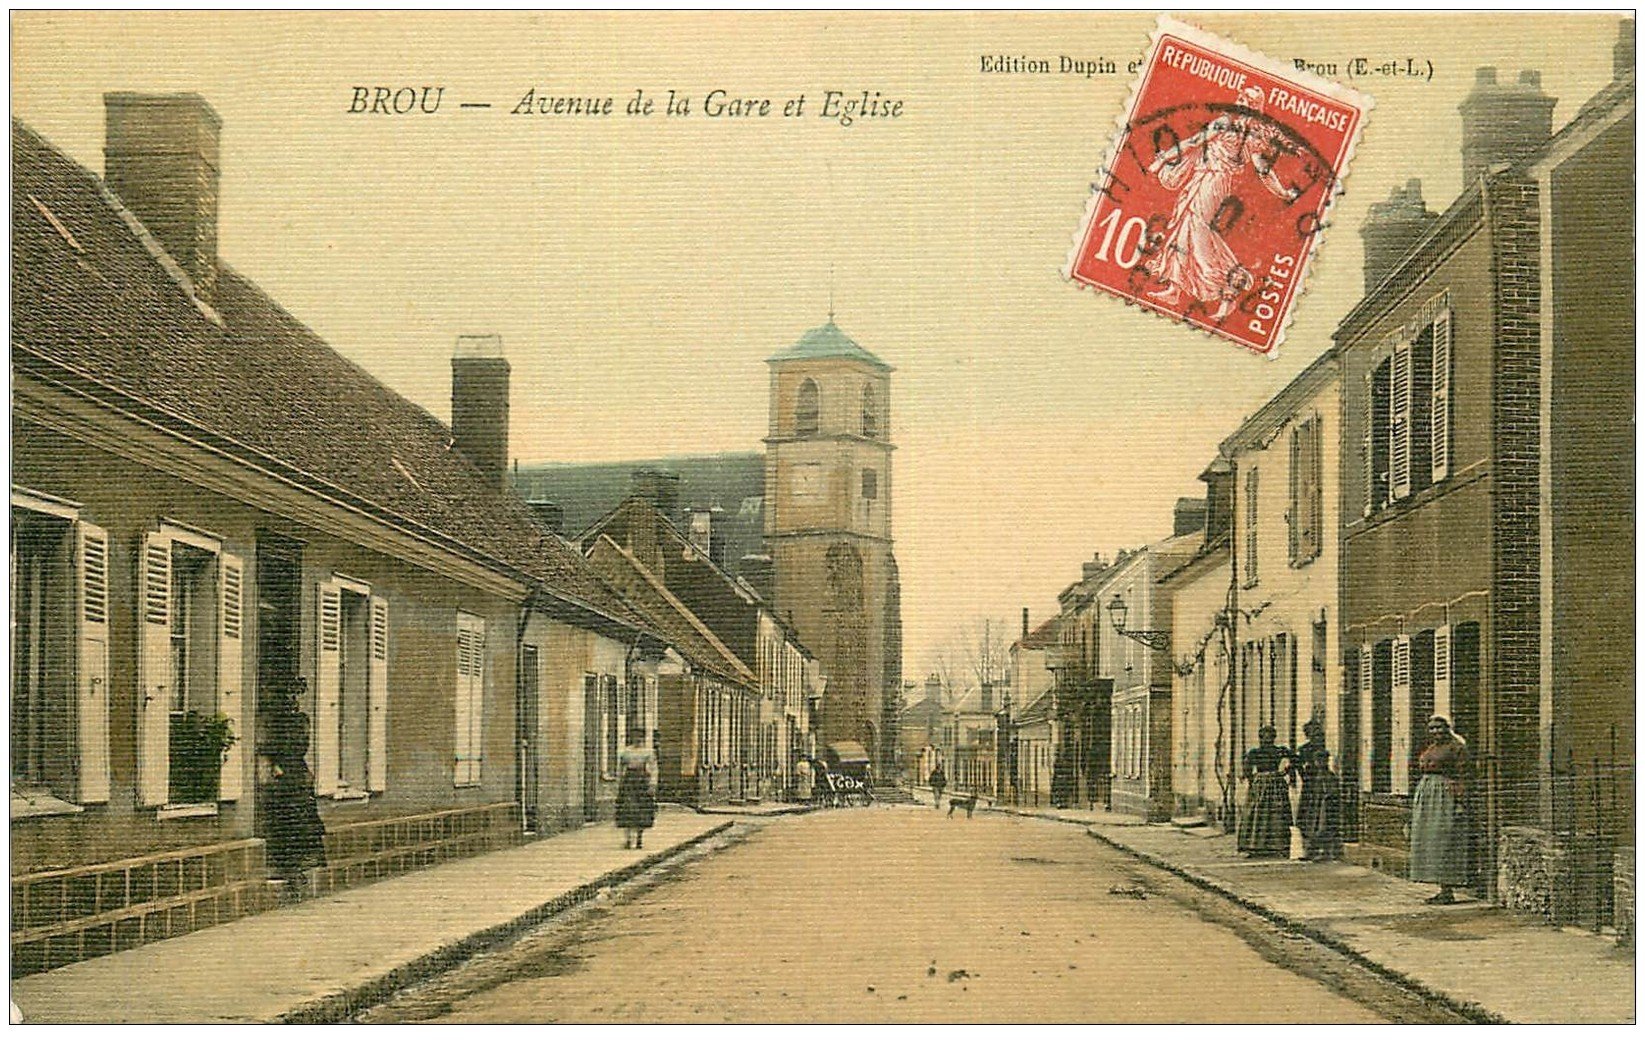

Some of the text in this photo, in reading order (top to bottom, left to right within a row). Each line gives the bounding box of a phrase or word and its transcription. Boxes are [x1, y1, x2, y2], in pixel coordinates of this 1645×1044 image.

[1161, 45, 1348, 132] REPUBLIQUE FRANÇAISE
[1093, 207, 1148, 269] 10
[1247, 252, 1295, 336] POSTES
